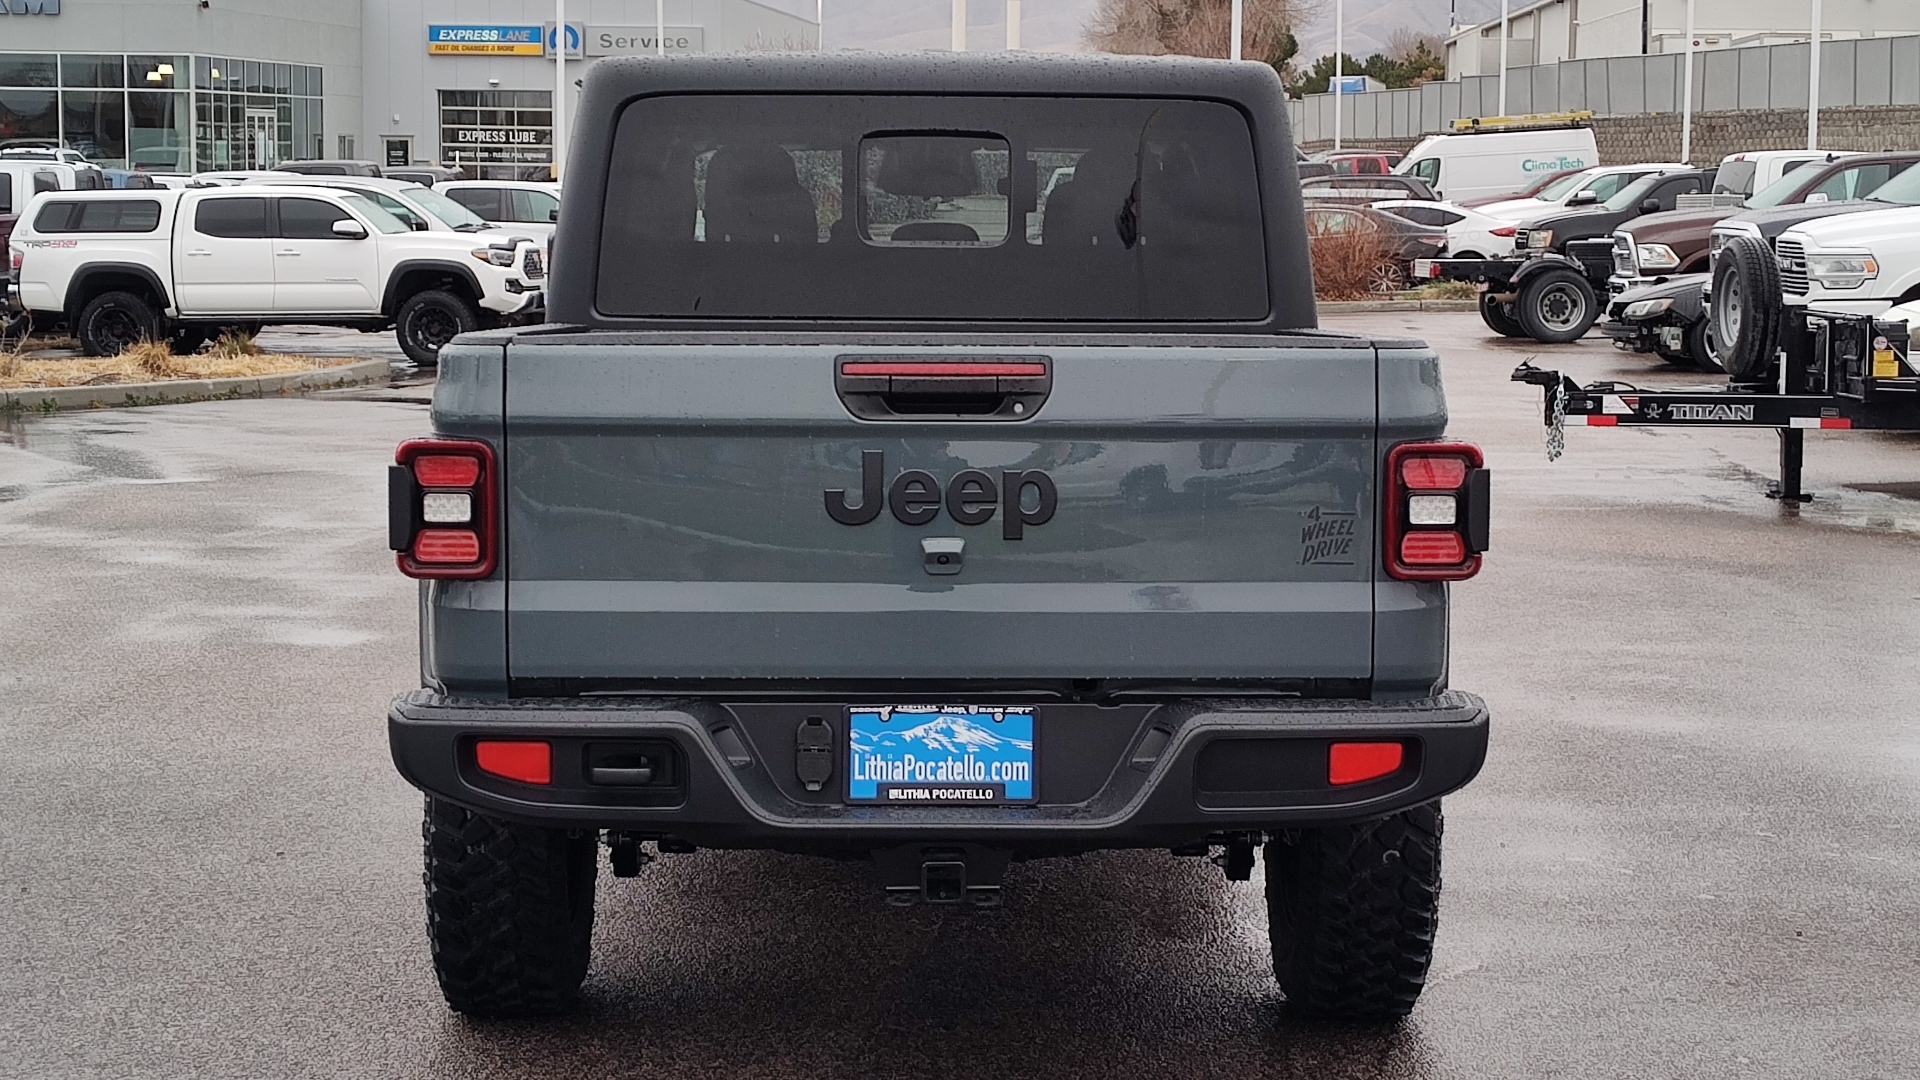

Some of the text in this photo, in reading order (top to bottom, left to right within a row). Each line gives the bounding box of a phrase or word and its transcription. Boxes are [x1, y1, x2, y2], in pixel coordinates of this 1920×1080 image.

[458, 130, 537, 143] EXPRESS LUBE
[1667, 403, 1755, 420] TITAN
[824, 449, 1058, 541] Jeep
[1307, 505, 1321, 522] 4
[1301, 519, 1355, 544] WHEEL
[1301, 537, 1354, 566] DRIVE
[853, 753, 1030, 782] LithiaPocatello.com
[897, 788, 994, 800] LITHIA POCATELLO
